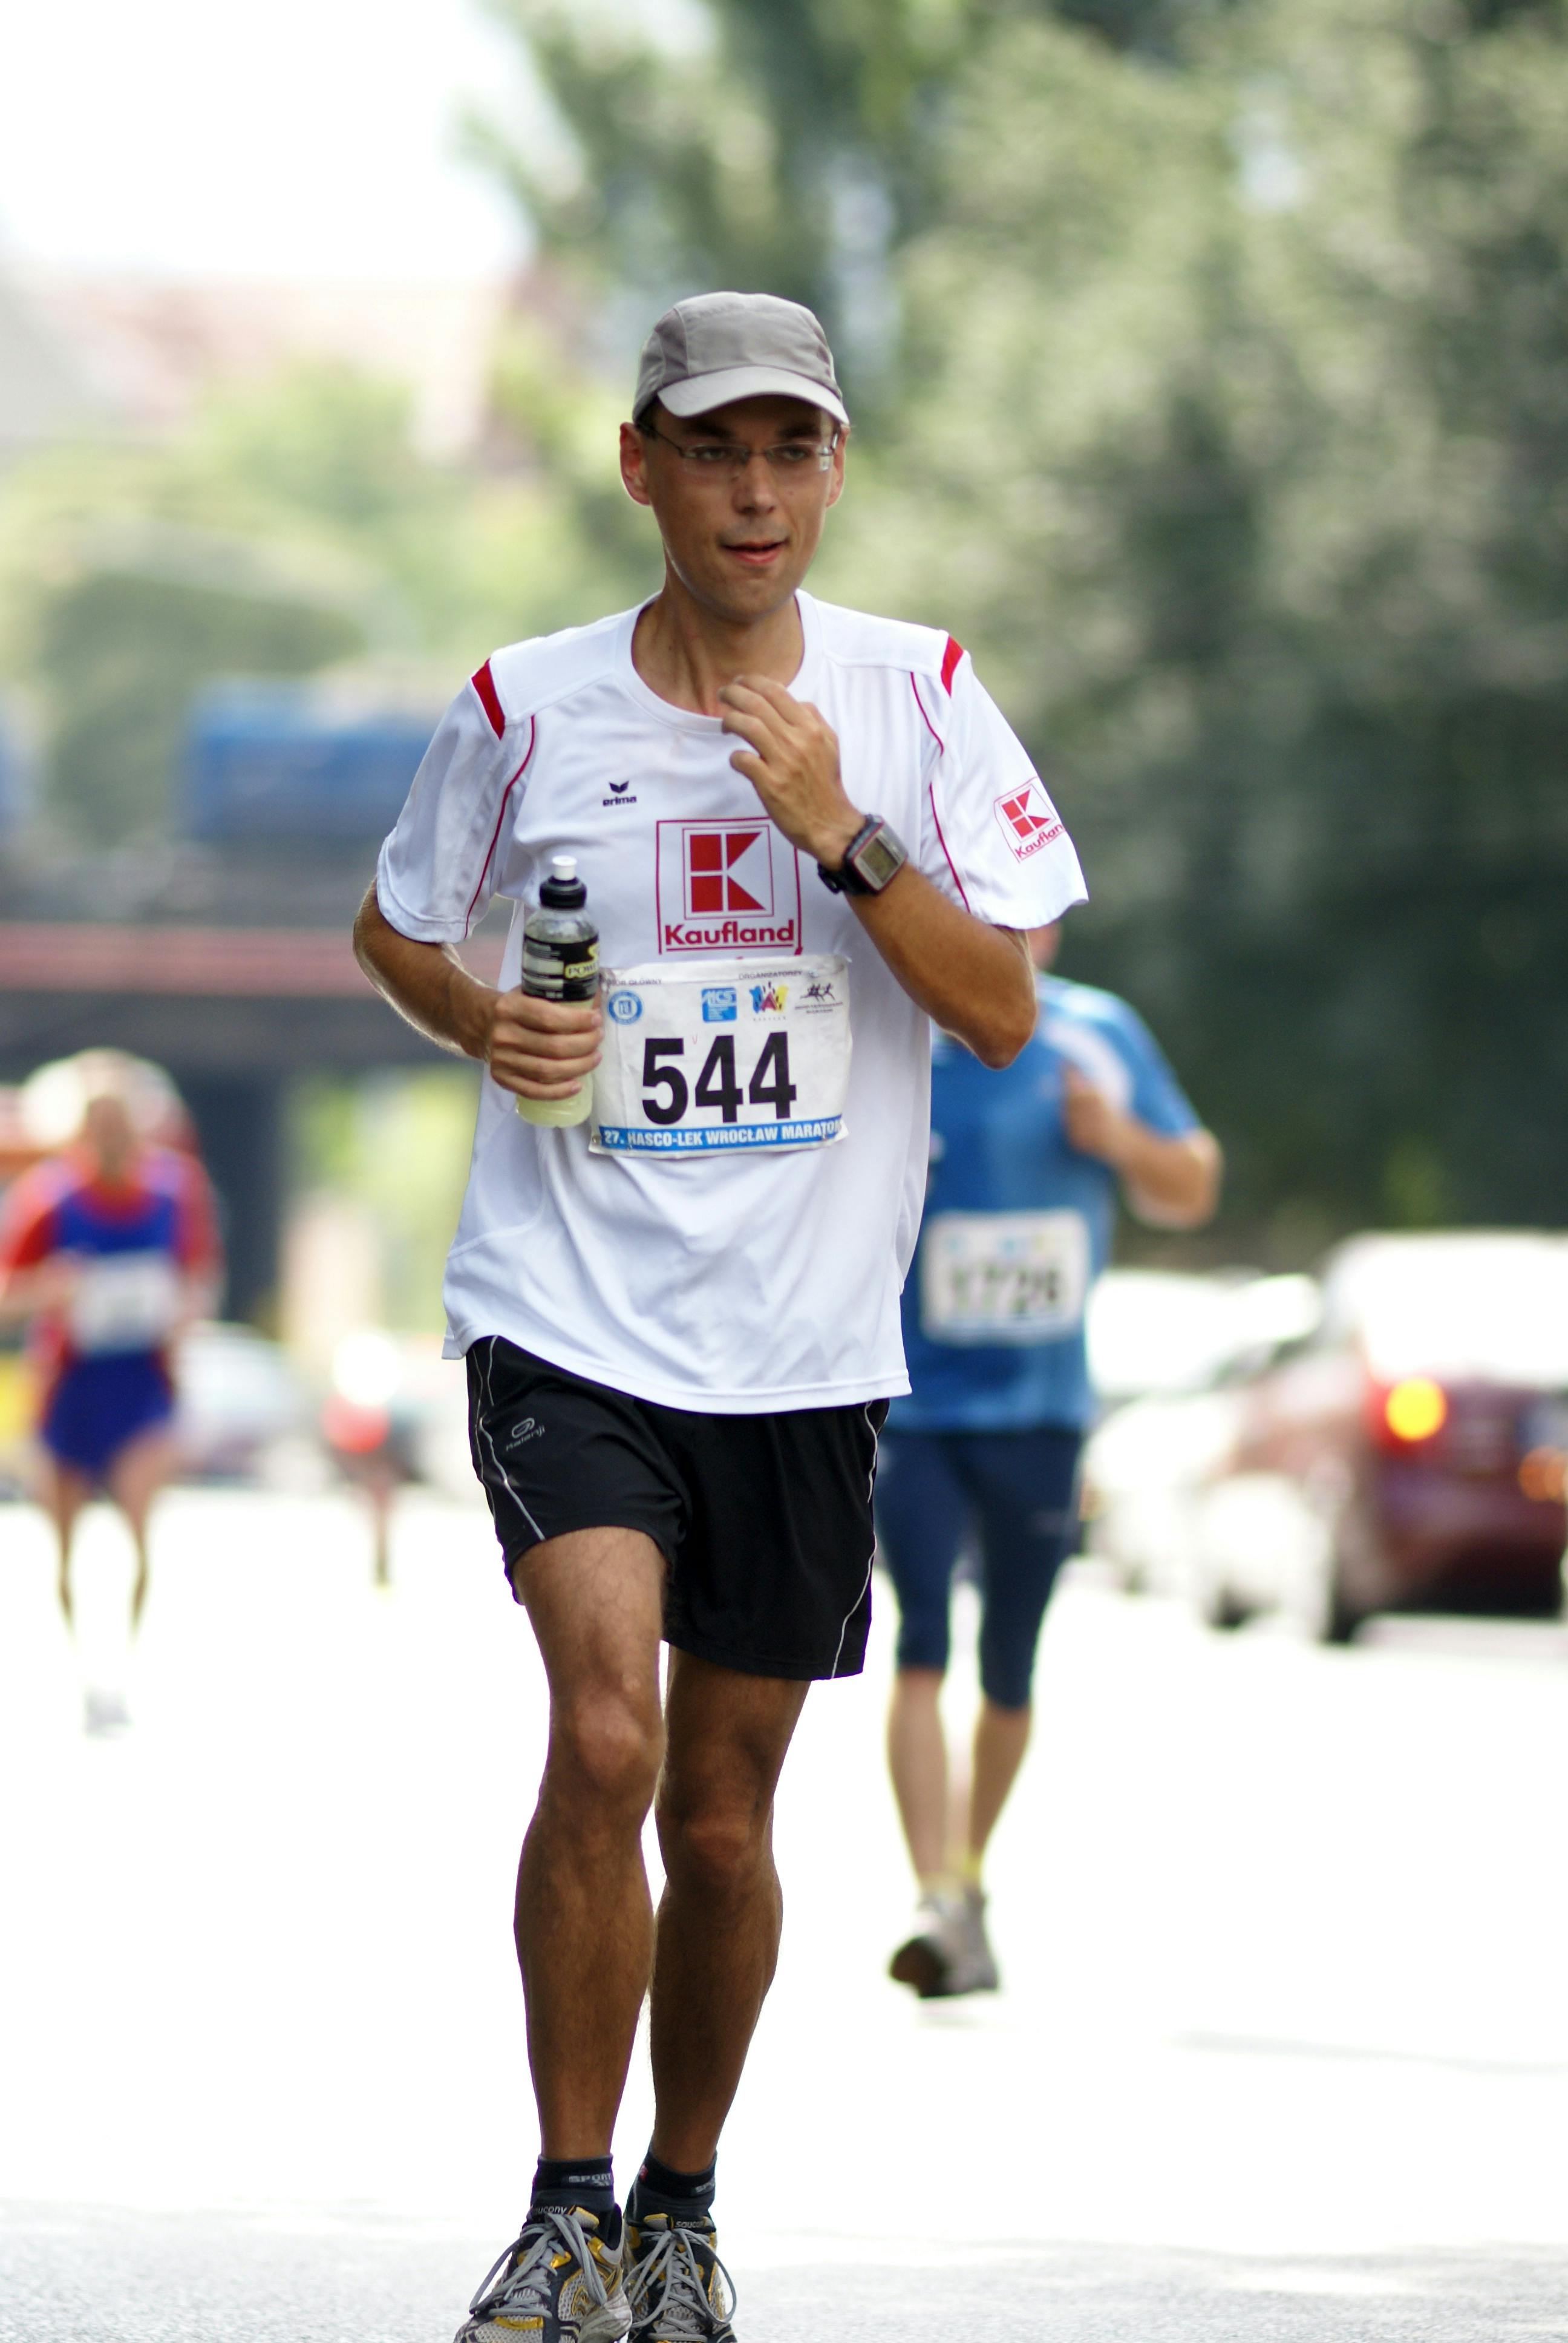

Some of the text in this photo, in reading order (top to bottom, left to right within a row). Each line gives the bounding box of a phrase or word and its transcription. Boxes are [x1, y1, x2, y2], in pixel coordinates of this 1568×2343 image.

[603, 796, 636, 807] erima
[665, 919, 794, 946] Kaufland
[642, 1031, 797, 1126] 544
[604, 1130, 624, 1144] 27.
[627, 1131, 703, 1147] HASCO-LEK
[706, 1126, 777, 1145] WROCŁAW
